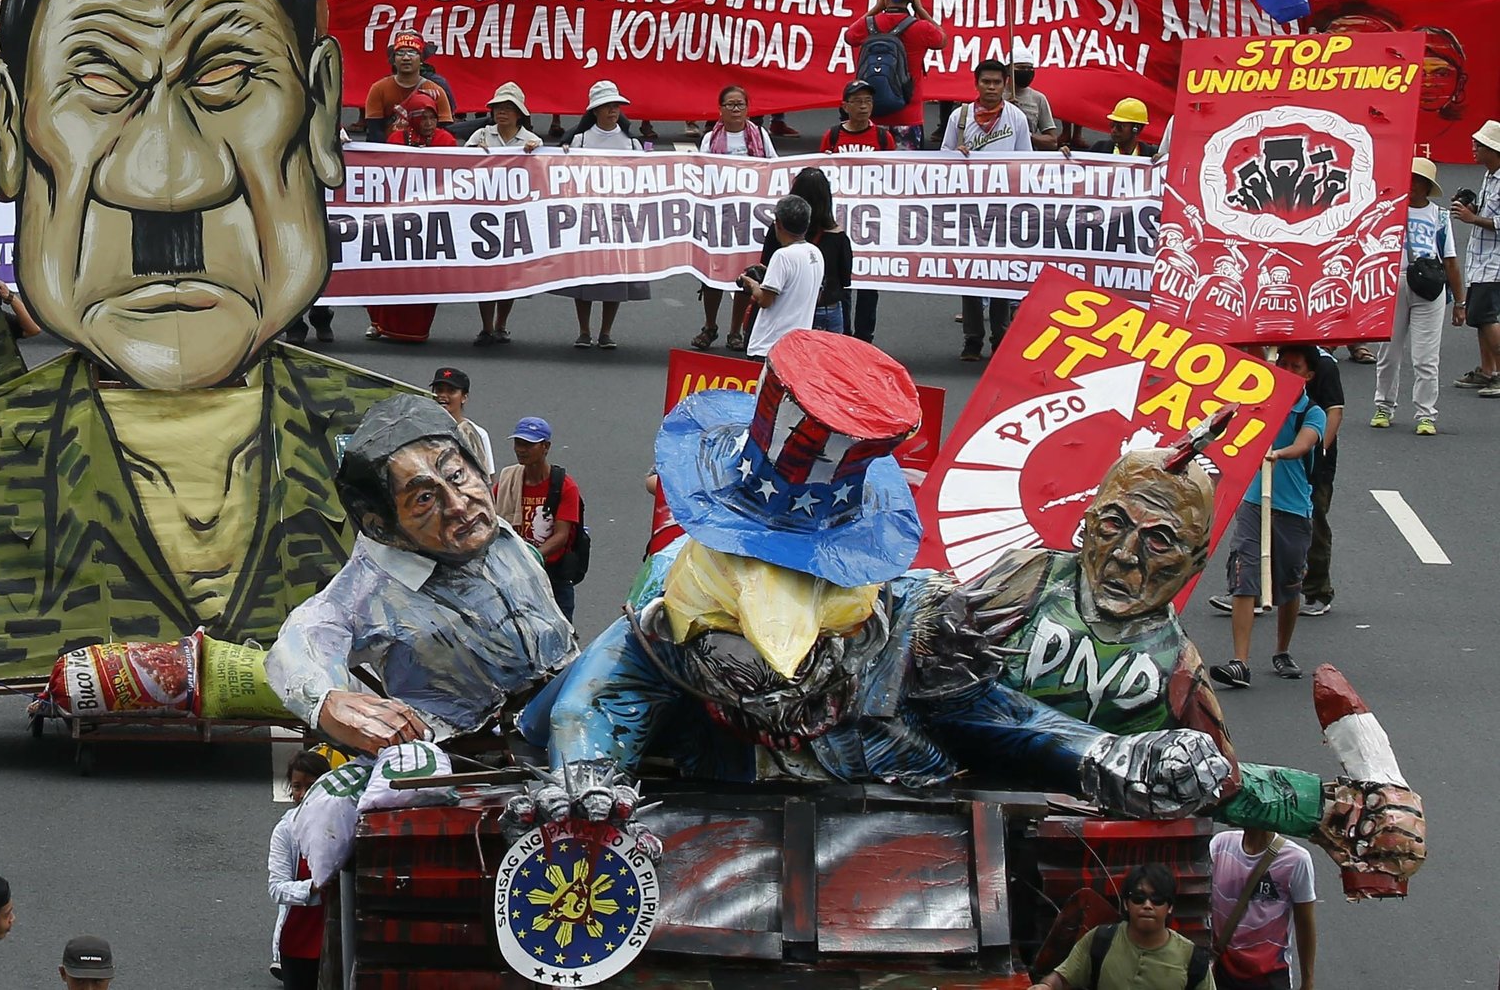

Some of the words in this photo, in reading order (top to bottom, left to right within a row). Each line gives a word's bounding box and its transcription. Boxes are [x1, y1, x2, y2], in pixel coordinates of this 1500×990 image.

[606, 9, 813, 71] KOMUNIDAD
[1237, 36, 1352, 66] STOP
[1186, 68, 1281, 94] UNION
[1288, 64, 1419, 93] BUSTING!
[549, 163, 760, 199] PYUDALISMO
[831, 162, 1005, 198] BURUKRATA
[329, 210, 458, 263] PARA
[470, 210, 534, 261] SA
[1152, 259, 1197, 303] PULIS
[1308, 285, 1348, 314] PULIS
[1352, 262, 1399, 305] PULIS
[1206, 285, 1244, 317] PULIS
[1258, 296, 1298, 312] PULIS
[1048, 289, 1275, 405] SAHOD
[76, 672, 99, 710] Buco
[228, 659, 241, 699] ANGELICA
[240, 670, 256, 696] RICE
[625, 848, 644, 868] NG
[497, 856, 519, 928] SAGISAG
[520, 834, 542, 855] NG
[629, 873, 655, 948] PILIPINAS
